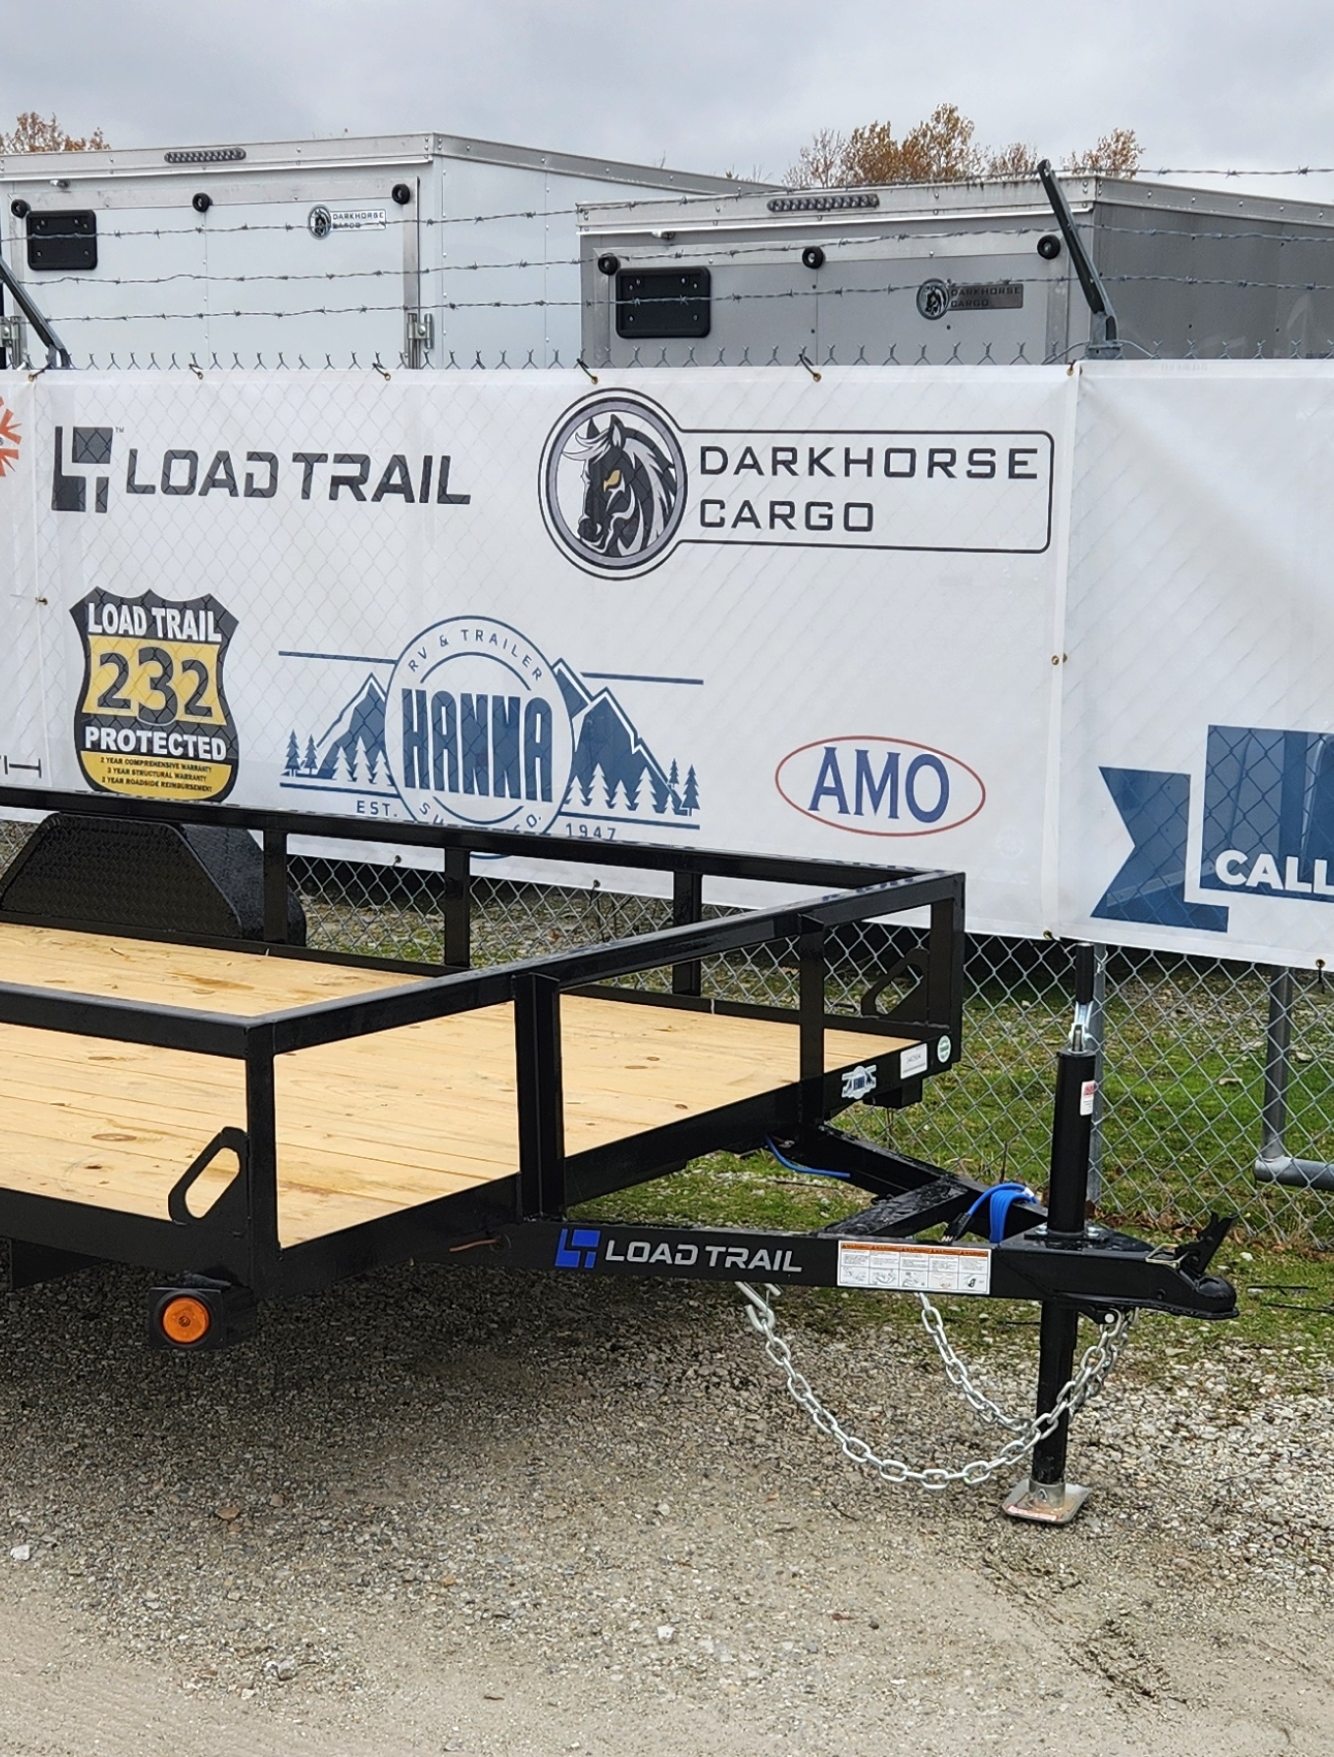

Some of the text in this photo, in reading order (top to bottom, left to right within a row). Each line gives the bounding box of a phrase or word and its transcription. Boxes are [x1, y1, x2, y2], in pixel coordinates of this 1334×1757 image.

[950, 286, 1021, 297] DARKHORSE
[950, 299, 989, 308] CARGO
[125, 447, 471, 505] LOAD TRAIL
[699, 445, 1039, 479] DARKHORSE
[699, 498, 874, 533] CARGO
[87, 602, 222, 643] LOAD TRAIL
[407, 628, 543, 680] RV & TRAILER
[97, 646, 213, 726] 232
[85, 725, 227, 761] PROTECTED
[401, 687, 553, 803] HANNA
[106, 757, 123, 765] YEAR
[124, 758, 179, 769] COMPREHENSIVE
[180, 763, 212, 773] WARRANTY
[113, 767, 130, 775] YEAR
[131, 769, 173, 779] STRUCTURAL
[174, 773, 207, 782] WARRANTY
[107, 777, 124, 785] YEAR
[125, 778, 159, 788] ROADSIDE
[160, 781, 212, 792] REIMBURSEMENT
[807, 746, 950, 823] AMO
[356, 799, 399, 818] EST.
[566, 822, 618, 842] 1947
[604, 1239, 803, 1273] LOAD TRAIL
